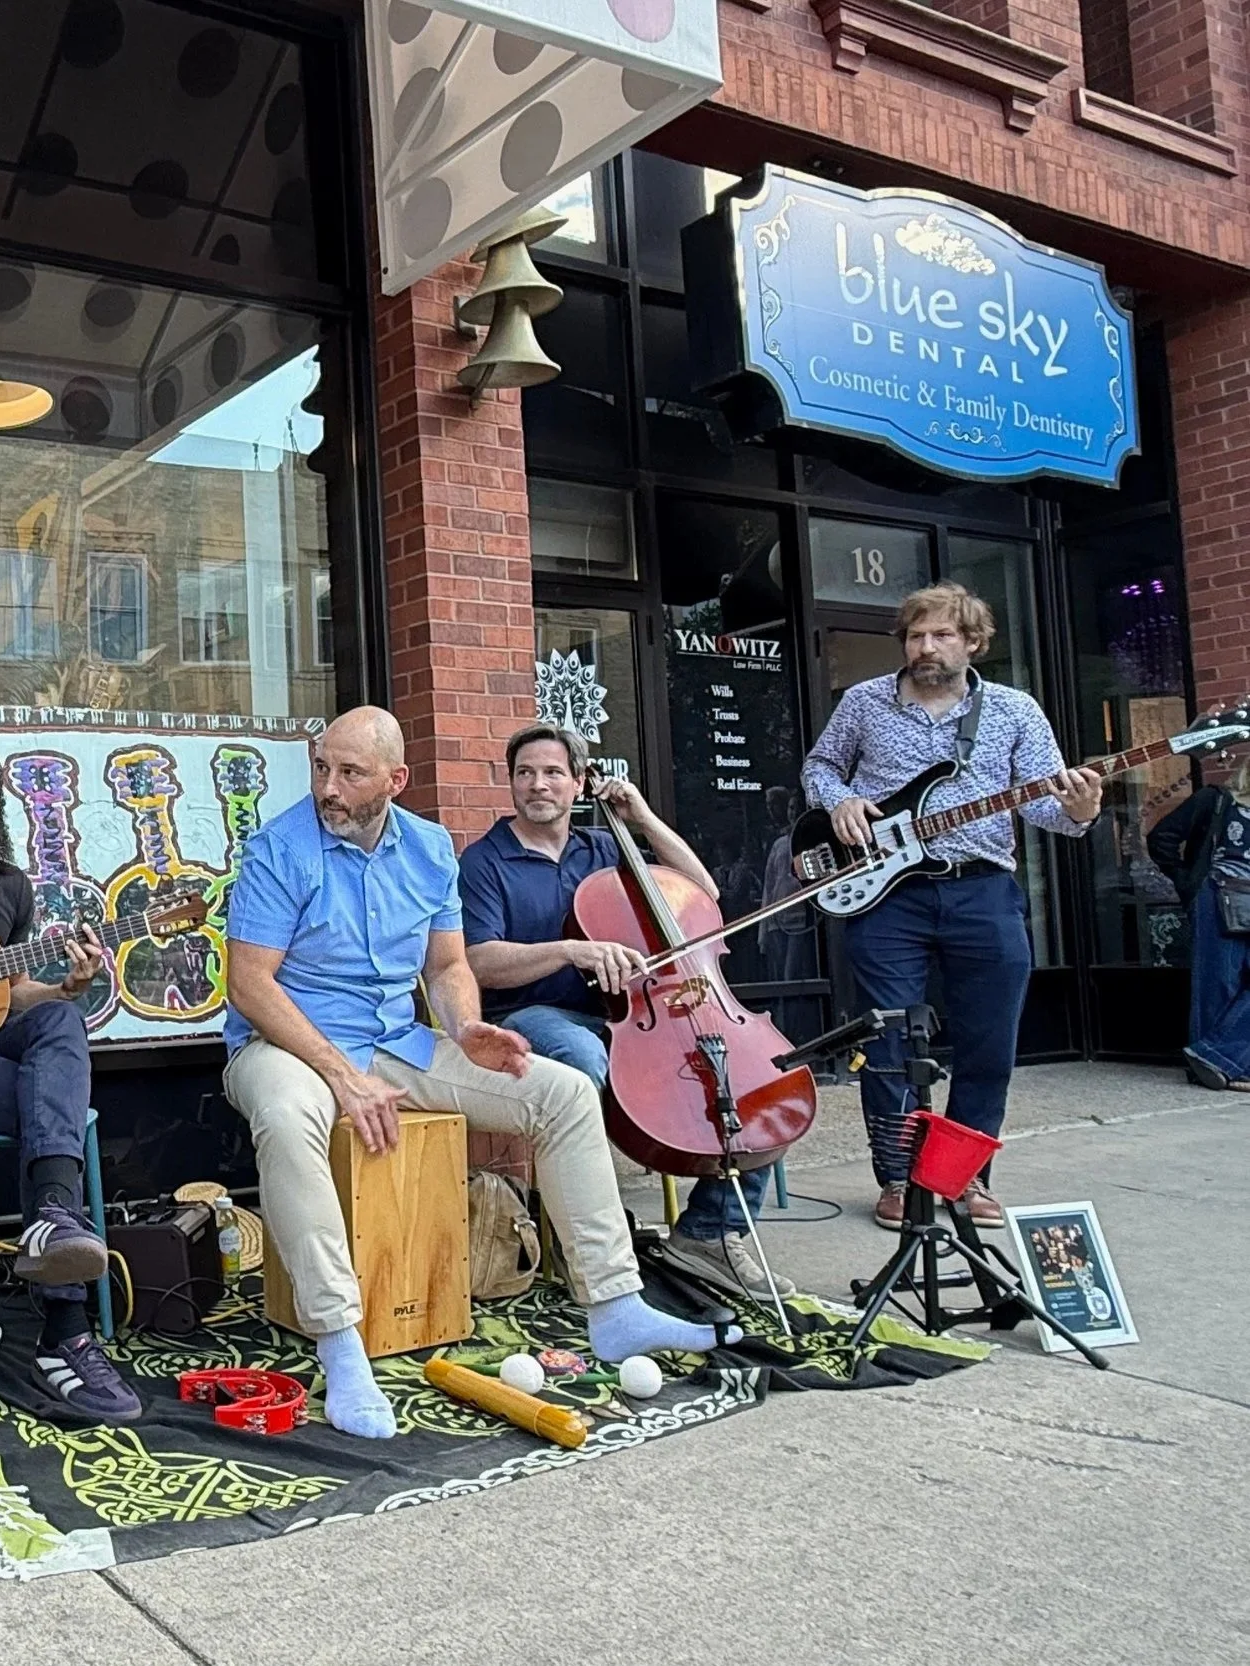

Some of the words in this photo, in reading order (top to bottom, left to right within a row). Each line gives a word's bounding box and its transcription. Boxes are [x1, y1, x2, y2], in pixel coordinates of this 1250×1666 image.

[835, 222, 963, 329] blue
[978, 270, 1068, 377] sky
[852, 322, 1024, 384] DENTAL
[809, 355, 911, 402] Cosmetic
[917, 380, 937, 408] &
[944, 385, 1007, 431] Family
[1013, 400, 1094, 449] Dentistry
[851, 547, 886, 586] 18
[675, 629, 782, 658] YANOWITZ
[733, 660, 746, 670] Law
[748, 661, 762, 671] Firm
[766, 664, 782, 672] PLLC
[711, 684, 734, 698] Wills
[712, 708, 740, 721] Trusts
[714, 731, 746, 744] Probate
[716, 755, 750, 768] Business
[717, 778, 736, 790] Real
[737, 779, 762, 791] Estate
[394, 1304, 416, 1317] PYLE
